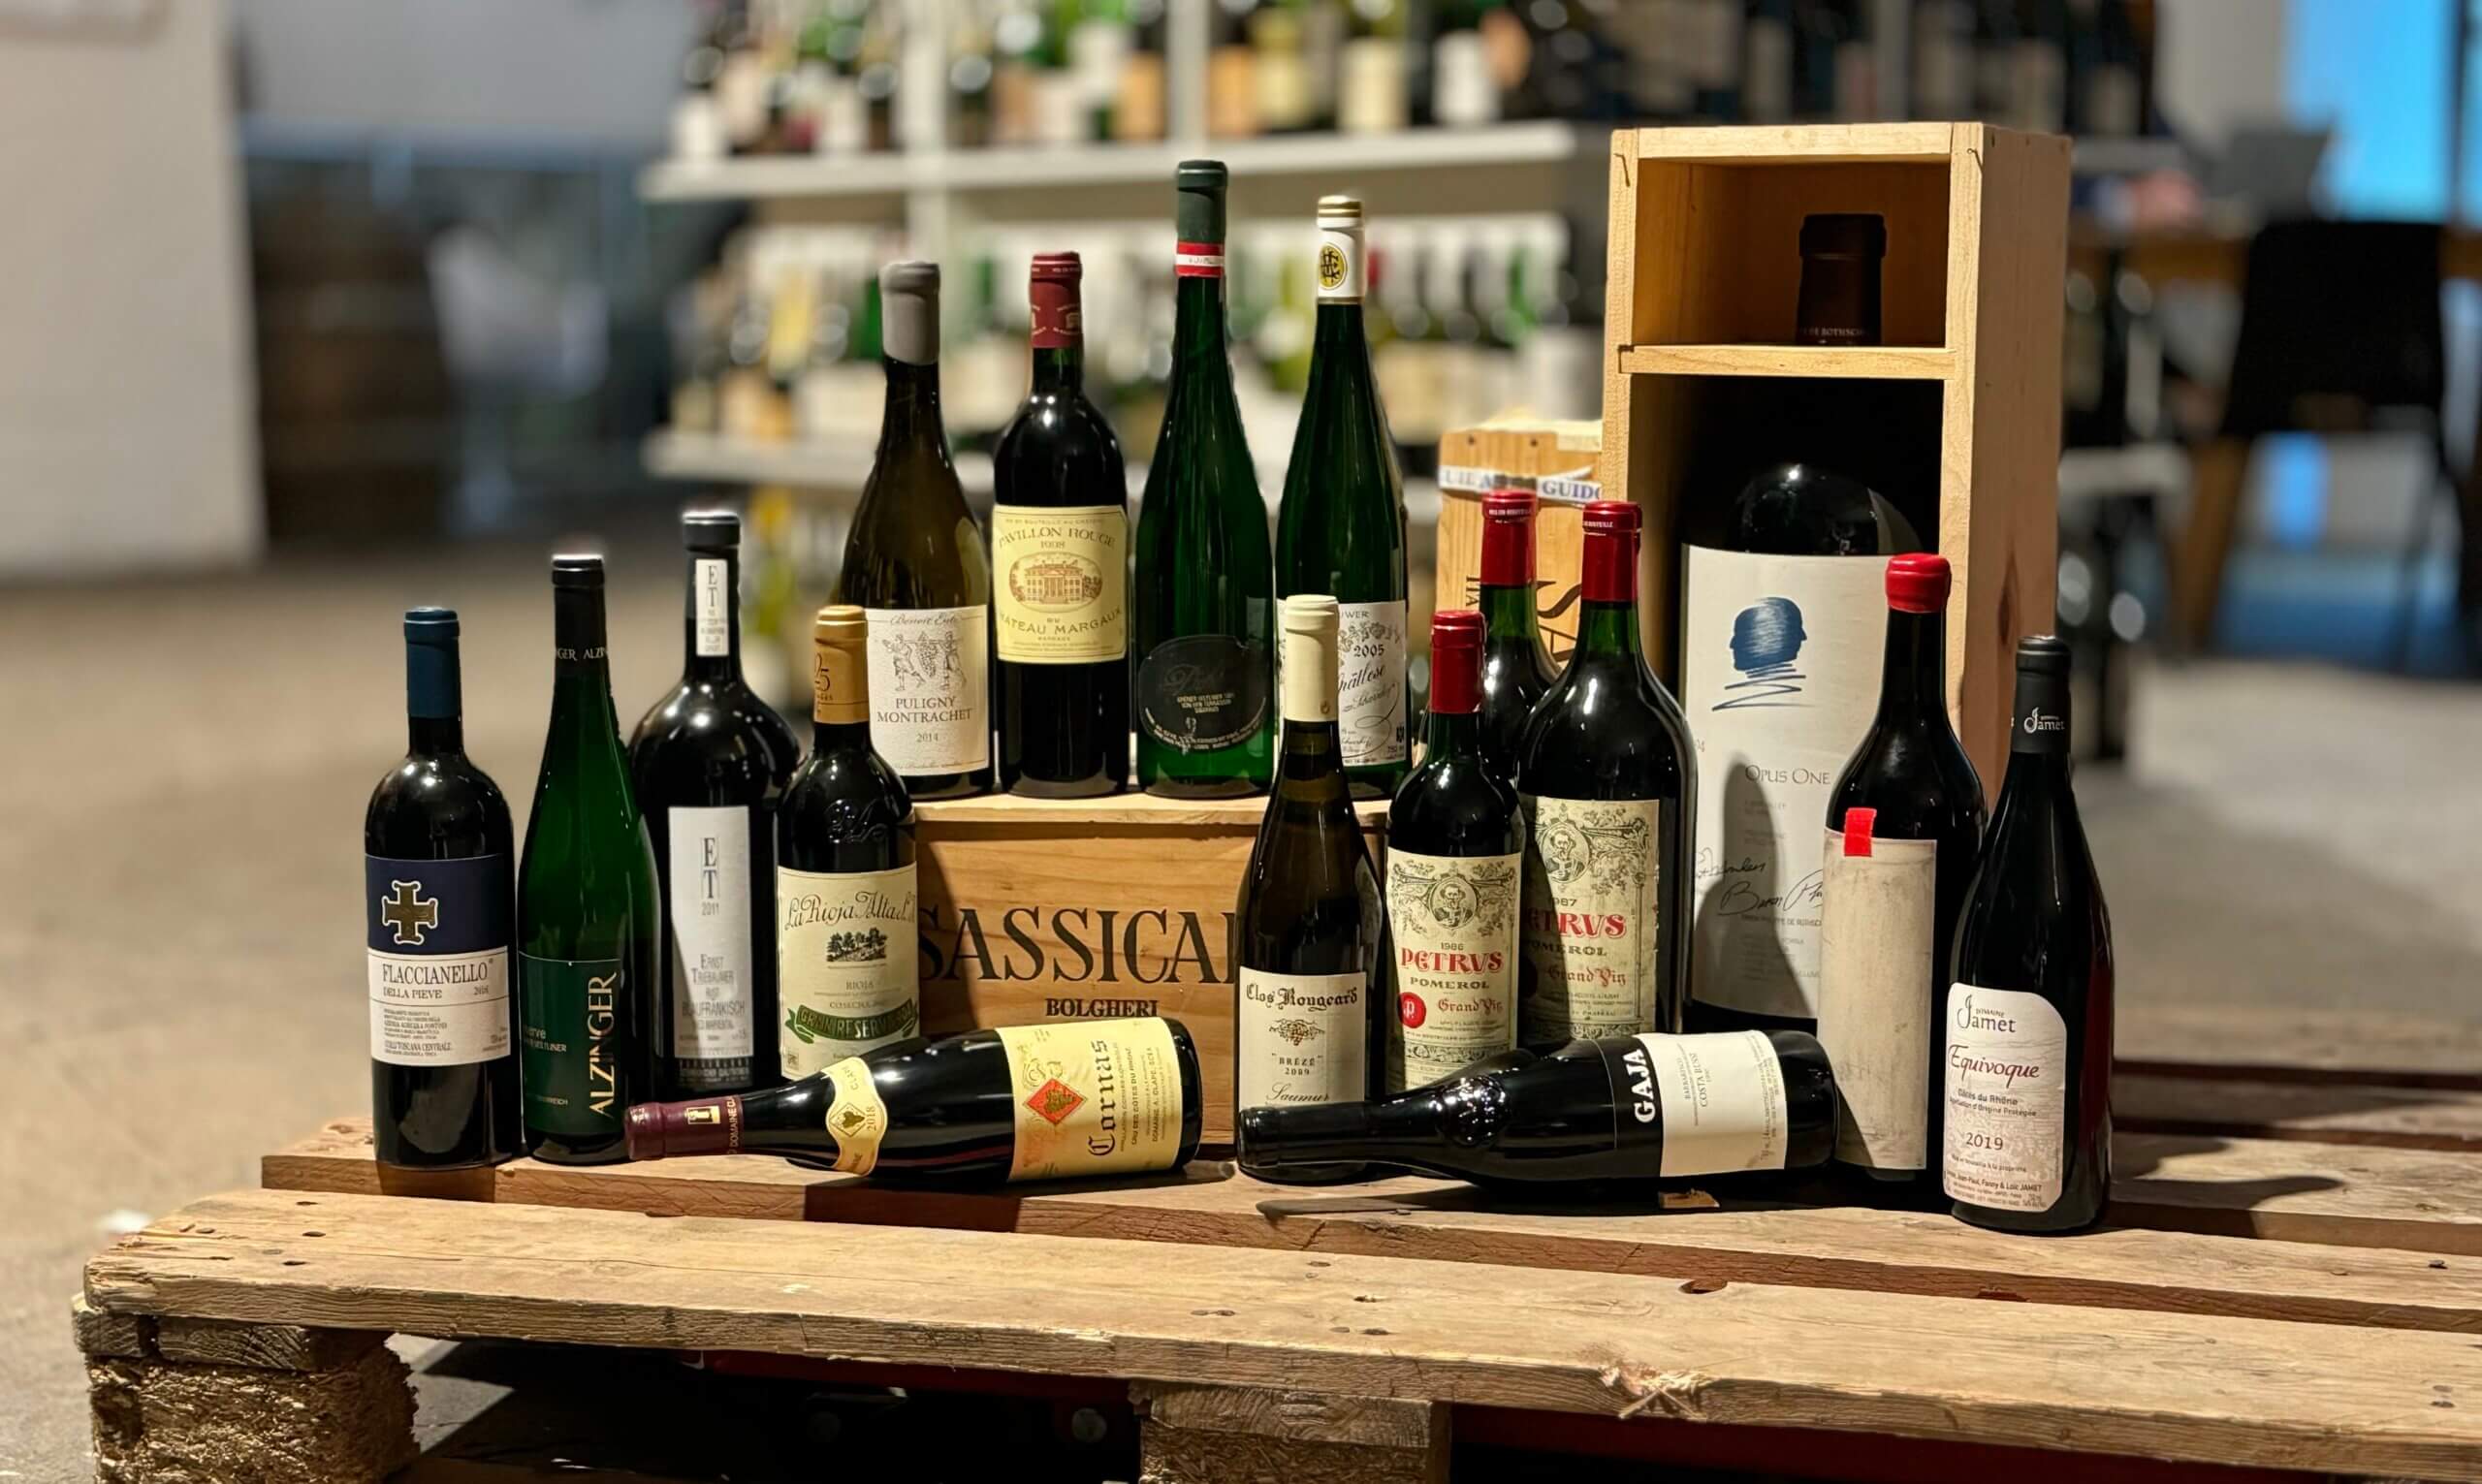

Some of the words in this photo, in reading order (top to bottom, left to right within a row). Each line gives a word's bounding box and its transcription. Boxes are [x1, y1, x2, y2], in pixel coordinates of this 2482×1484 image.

[1067, 526, 1116, 548] ROUGE
[1054, 606, 1123, 636] MARGAUX
[1353, 645, 1384, 657] 2005
[896, 696, 956, 710] PULIGNY
[877, 708, 972, 724] MONTRACHET
[2023, 706, 2065, 734] Jamet
[916, 733, 939, 743] 2014
[800, 893, 854, 927] Rioja
[918, 906, 1236, 984] SASSICAI
[1400, 946, 1503, 975] PETRVS
[382, 962, 488, 985] FLACCIANELLO
[845, 980, 875, 991] RIOJA
[1411, 977, 1490, 990] POMEROL
[383, 987, 410, 999] DELLA
[412, 989, 443, 999] PIEVE
[1246, 983, 1276, 1008] Clos
[1276, 986, 1358, 1012] Rougeard
[1437, 996, 1479, 1013] Grand
[1045, 997, 1160, 1018] BOLGHERI
[1957, 994, 2017, 1033] Jamet
[800, 1009, 836, 1035] GRAN
[588, 971, 618, 1119] ALZINGER
[1949, 1043, 2040, 1089] Equivoque
[1087, 1040, 1117, 1156] Cornas
[1265, 1081, 1330, 1102] Saumur
[1622, 1048, 1657, 1124] GAJA
[1696, 1075, 1709, 1108] COSTA
[1977, 1092, 1988, 1103] du
[728, 1108, 740, 1148] DOMAINE
[867, 1105, 877, 1131] 2018
[1966, 1132, 2004, 1152] 2019
[2021, 1184, 2043, 1193] JAMET
